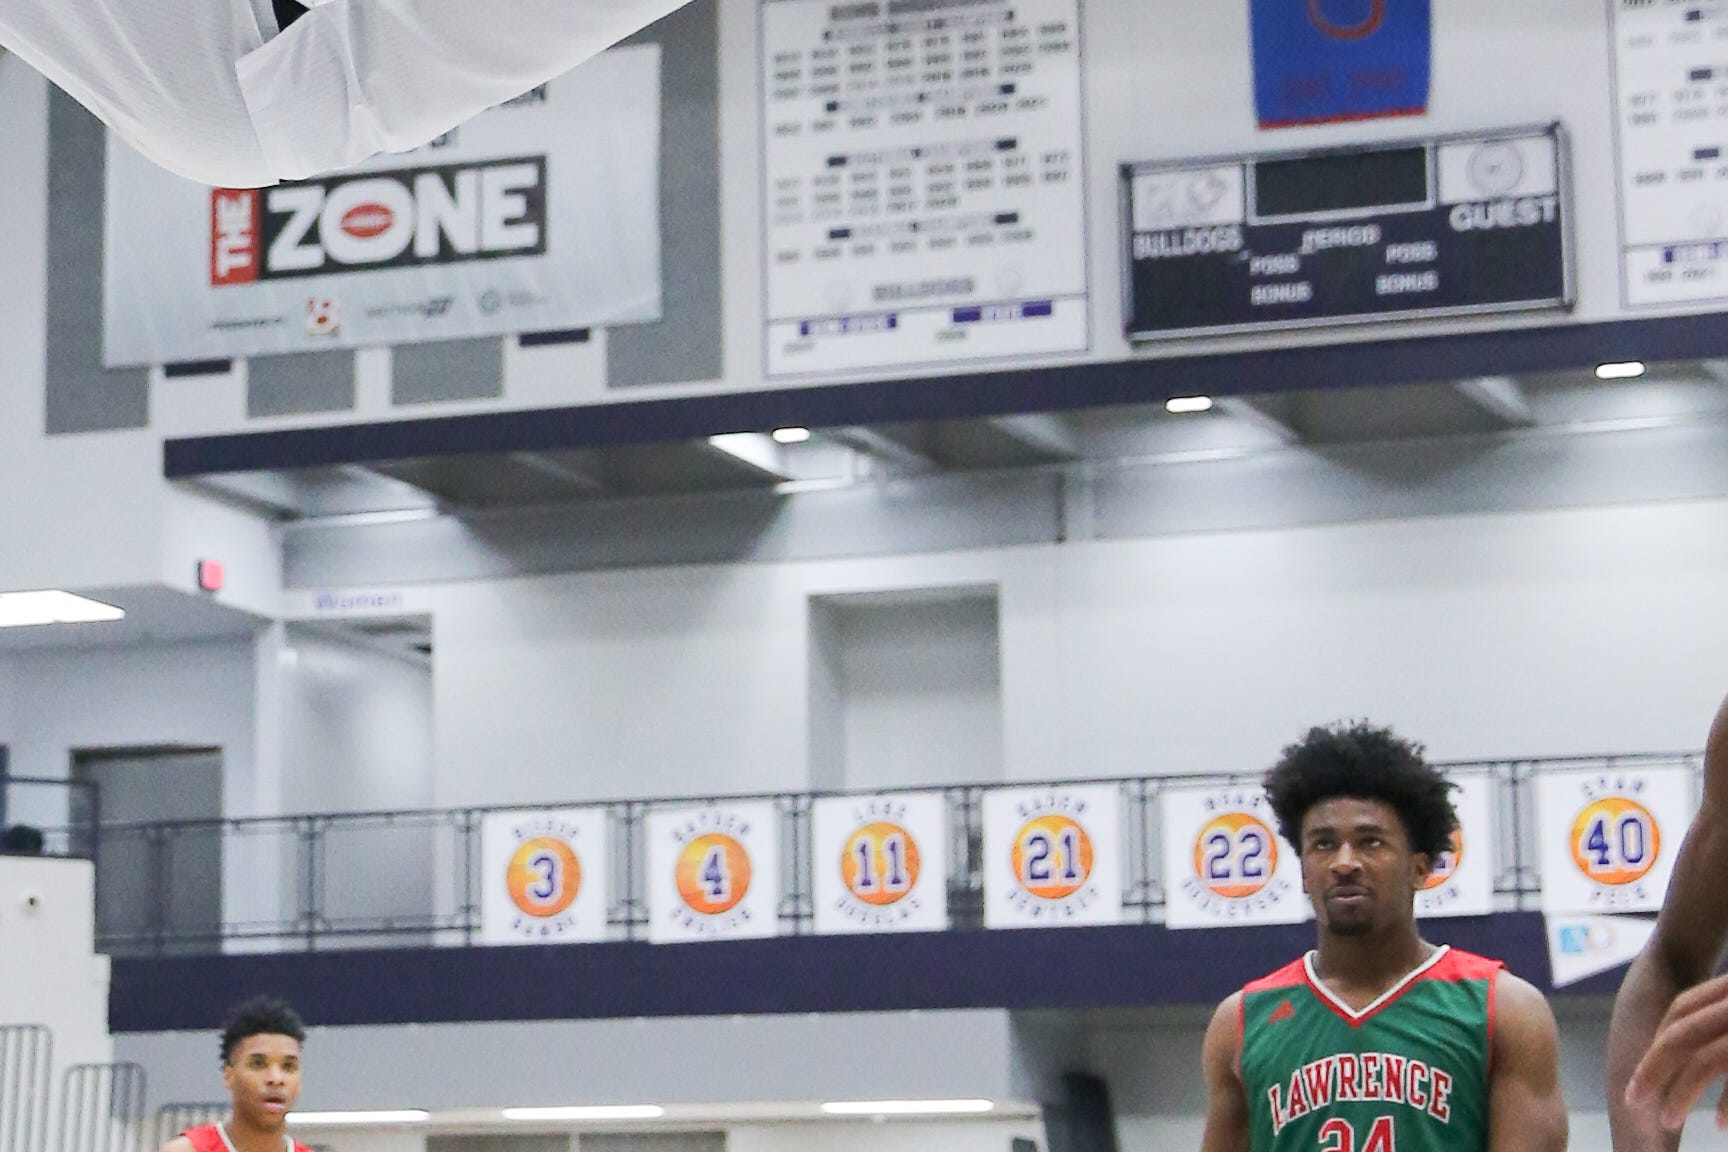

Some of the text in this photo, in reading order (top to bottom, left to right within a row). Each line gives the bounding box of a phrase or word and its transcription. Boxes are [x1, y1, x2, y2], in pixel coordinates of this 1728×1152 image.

[215, 193, 253, 279] THE
[267, 163, 540, 273] ZONE
[1448, 195, 1557, 232] GUEST
[1133, 225, 1243, 260] BULLDOGS
[855, 836, 906, 889] 11
[1026, 832, 1080, 883] 21
[1206, 829, 1266, 882] 22
[1584, 815, 1647, 868] 40
[528, 852, 559, 902] 3
[700, 849, 727, 898] 4
[1267, 1052, 1453, 1136] LAWRENCE
